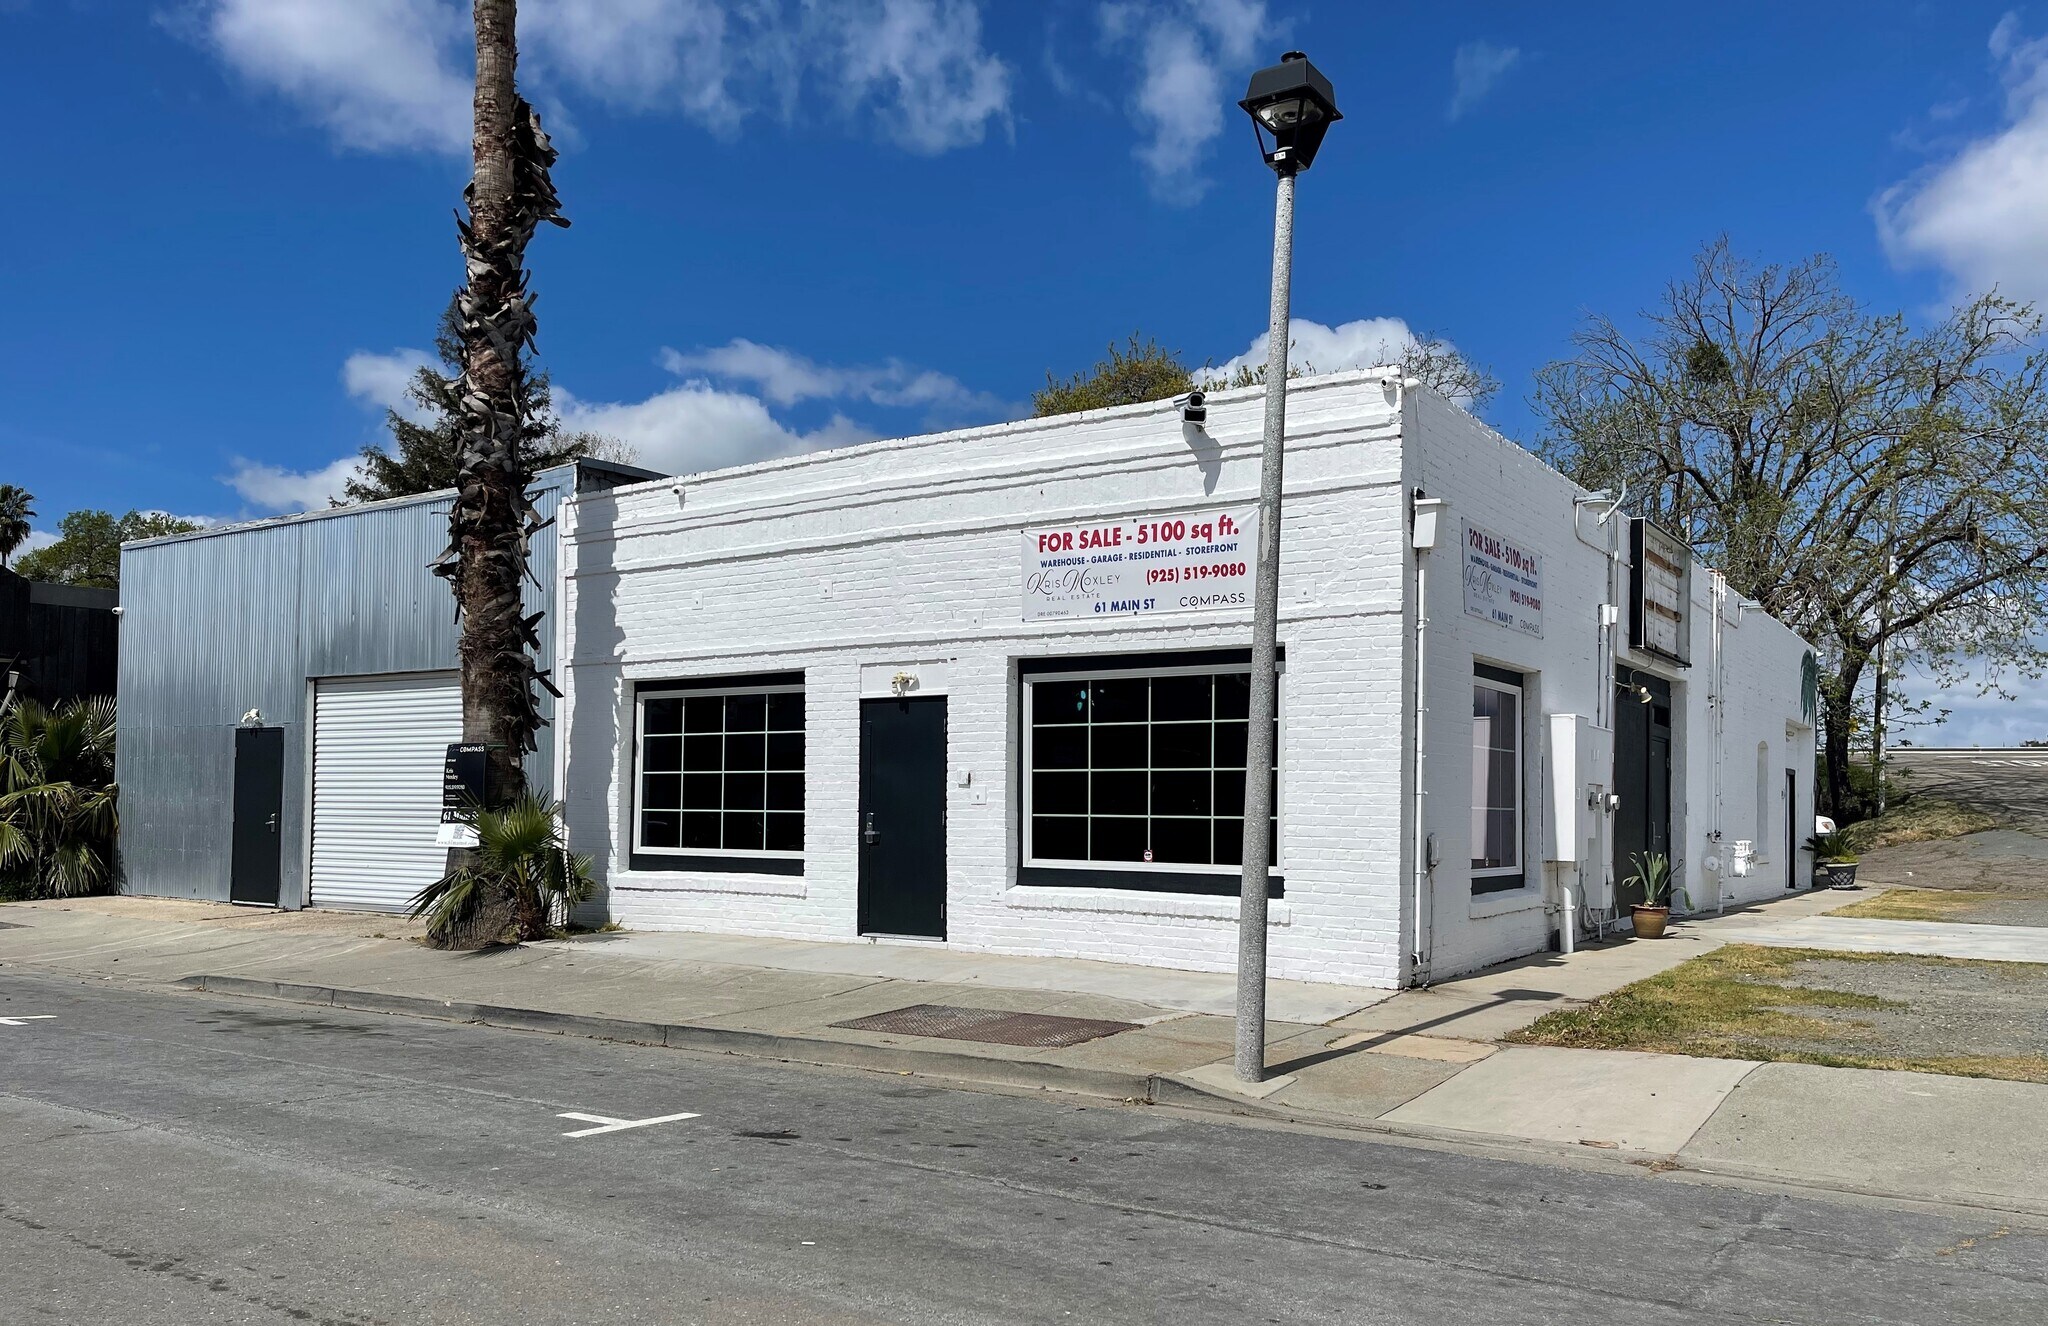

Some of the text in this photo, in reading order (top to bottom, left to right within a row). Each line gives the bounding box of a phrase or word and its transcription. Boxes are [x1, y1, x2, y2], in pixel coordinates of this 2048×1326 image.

[1038, 532, 1073, 553] FOR
[1079, 527, 1122, 550] SALE
[1137, 520, 1186, 544] 5100
[1190, 523, 1213, 543] sq
[1218, 514, 1240, 537] ft.
[1040, 557, 1085, 568] WAREHOUSE
[1091, 554, 1123, 564] GARAGE
[1129, 549, 1177, 561] RESIDENTIAL
[1185, 543, 1238, 556] STOREFRONT
[1469, 527, 1483, 552] FOR
[1485, 535, 1501, 560] SALE
[1505, 546, 1521, 569] 5100
[1522, 558, 1529, 577] sq
[1146, 562, 1246, 586] (925) 519-9080
[1071, 592, 1100, 600] ESTATE
[1180, 593, 1246, 607] COMPASS
[1094, 598, 1155, 613] 61 MAIN ST
[1492, 608, 1497, 620] 61
[1498, 610, 1508, 624] MAIN
[1520, 619, 1540, 634] COMPASS
[443, 811, 451, 821] 61
